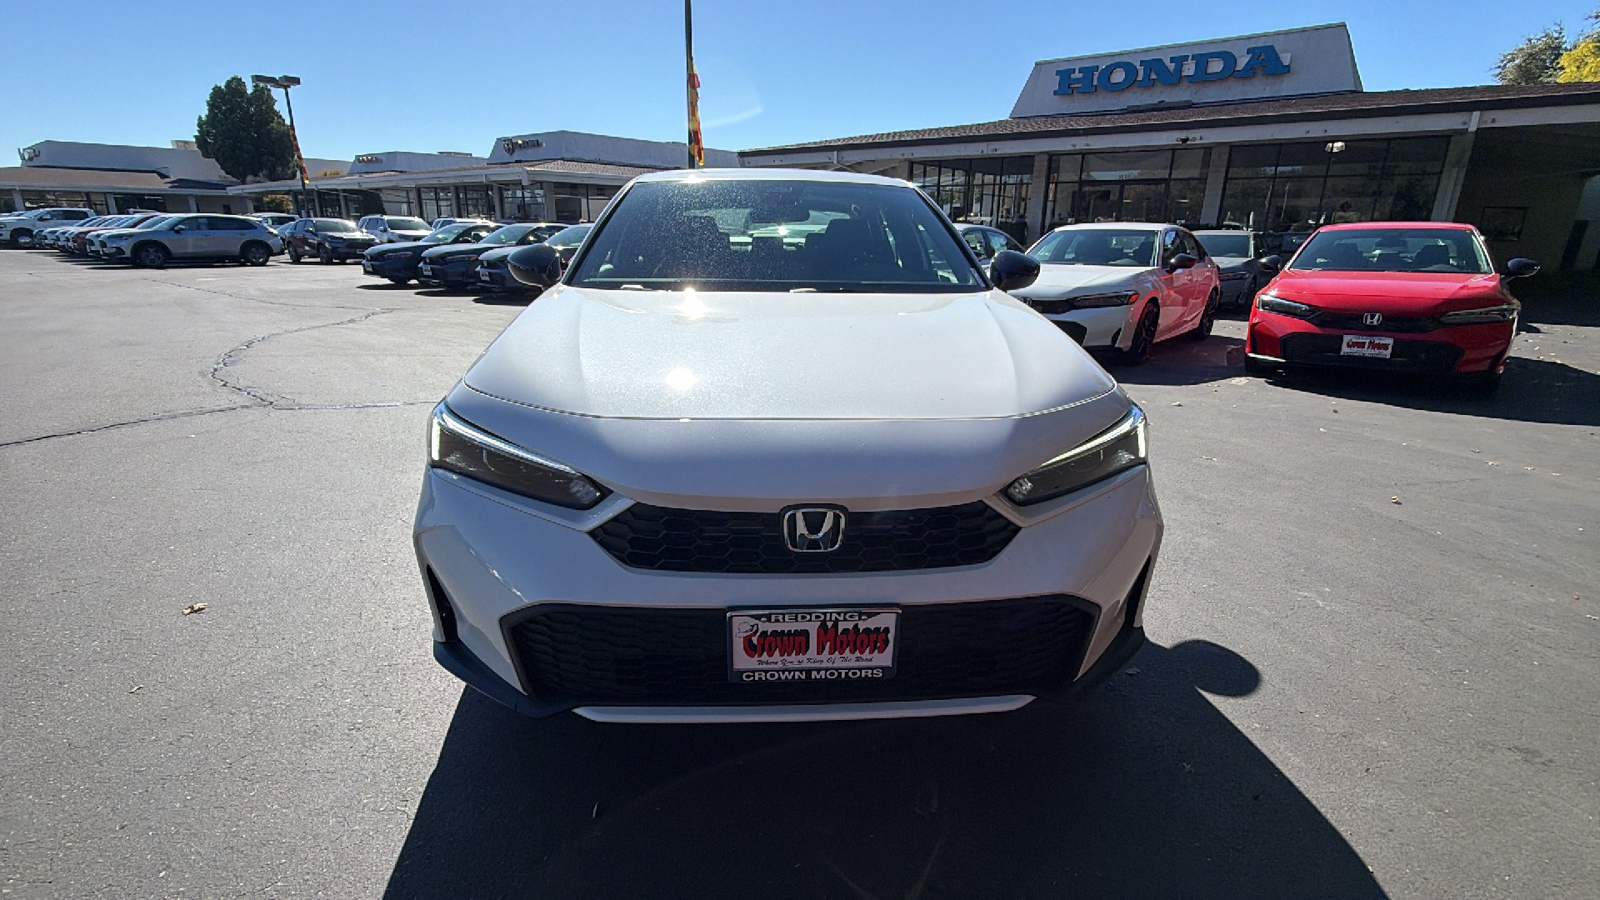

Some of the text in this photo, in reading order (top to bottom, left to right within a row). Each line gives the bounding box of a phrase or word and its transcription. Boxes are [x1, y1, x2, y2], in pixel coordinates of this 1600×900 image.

[1053, 45, 1291, 96] HONDA
[770, 612, 860, 623] REDDING
[742, 621, 890, 659] Crown Motors
[742, 668, 883, 682] CROWN MOTORS
